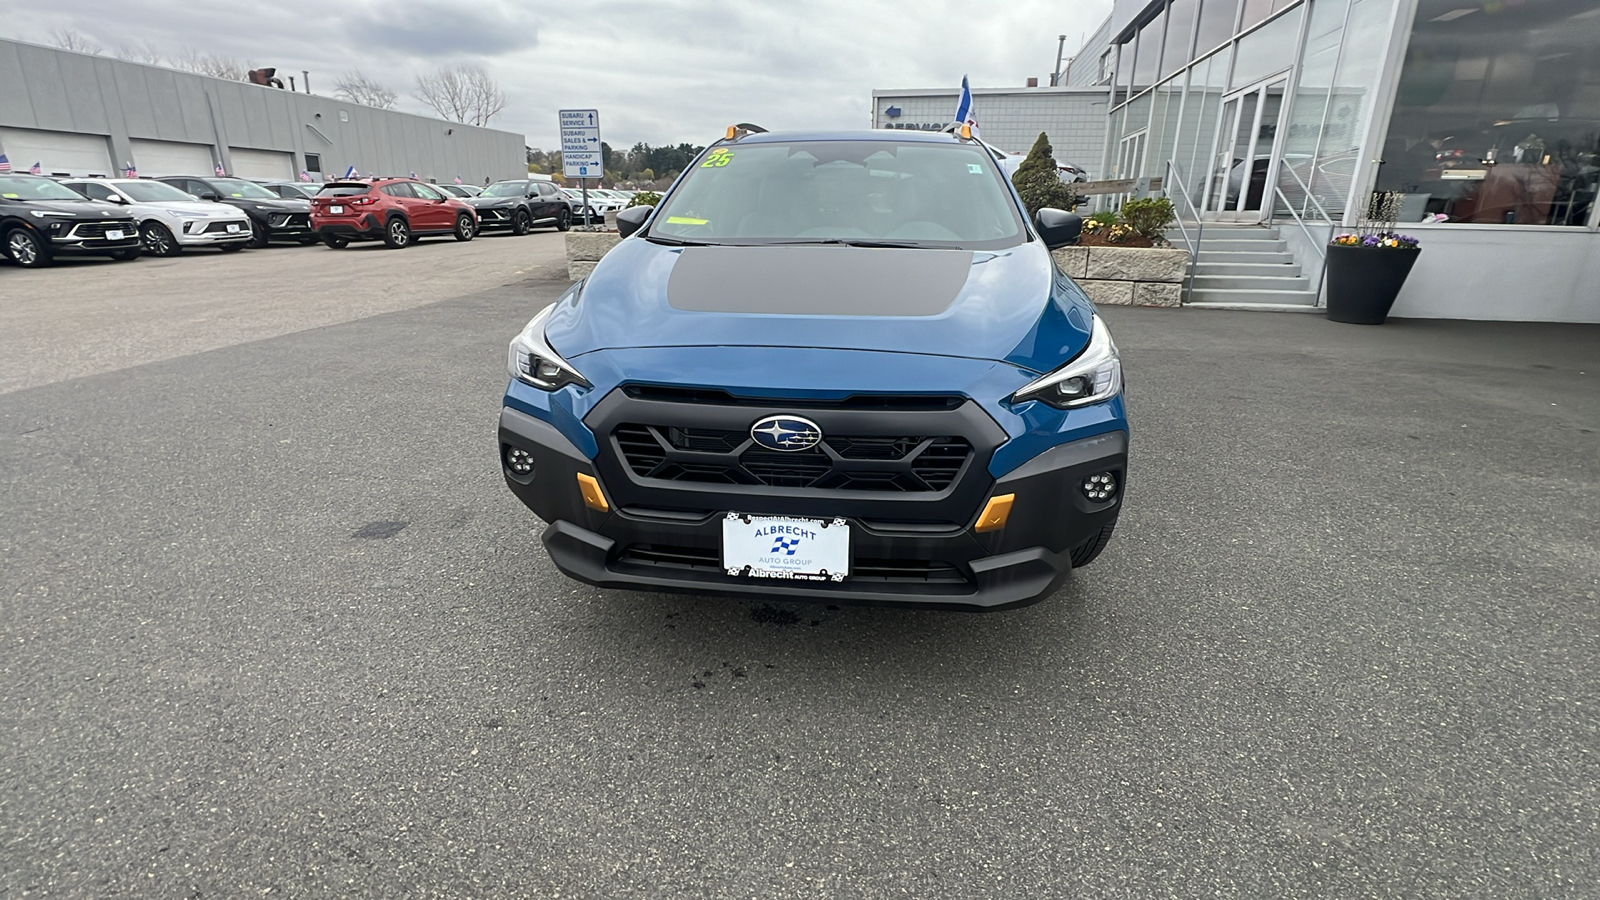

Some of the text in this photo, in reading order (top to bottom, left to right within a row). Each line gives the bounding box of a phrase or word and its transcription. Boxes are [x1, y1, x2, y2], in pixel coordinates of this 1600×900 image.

[885, 123, 950, 131] SERVIC
[700, 153, 735, 168] 25
[754, 526, 816, 540] ALBRECHT
[748, 568, 794, 580] Albrecht
